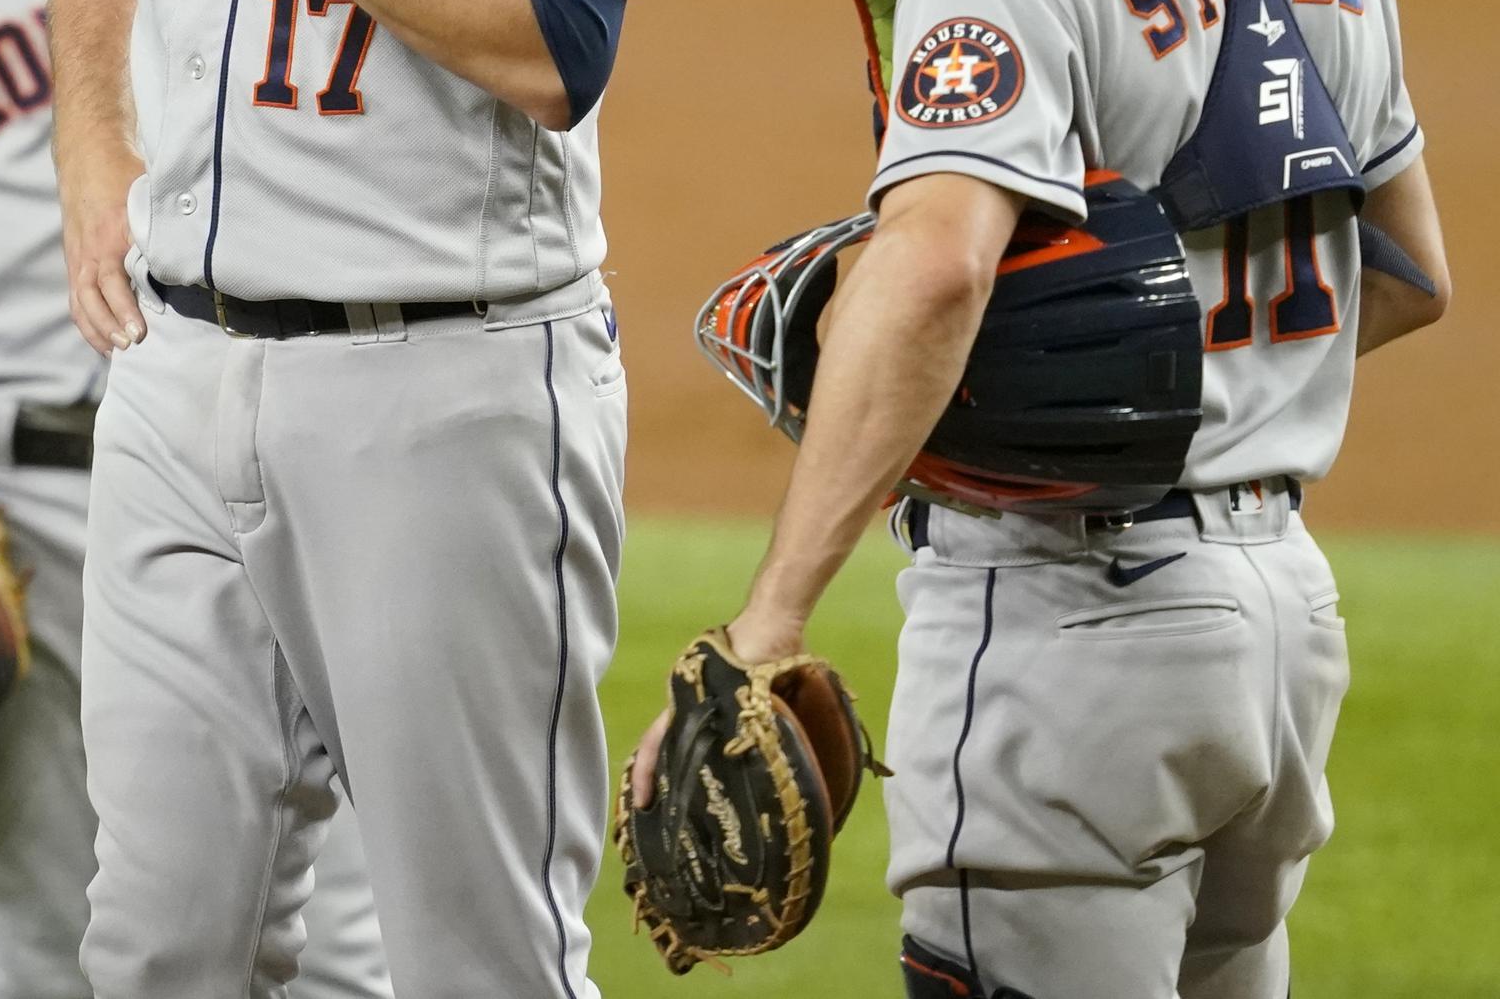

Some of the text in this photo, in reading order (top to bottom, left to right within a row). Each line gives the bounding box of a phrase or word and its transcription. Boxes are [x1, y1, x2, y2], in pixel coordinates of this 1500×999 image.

[912, 23, 1010, 63] HOUSTON
[929, 54, 981, 96] H
[907, 97, 998, 123] ASTROS
